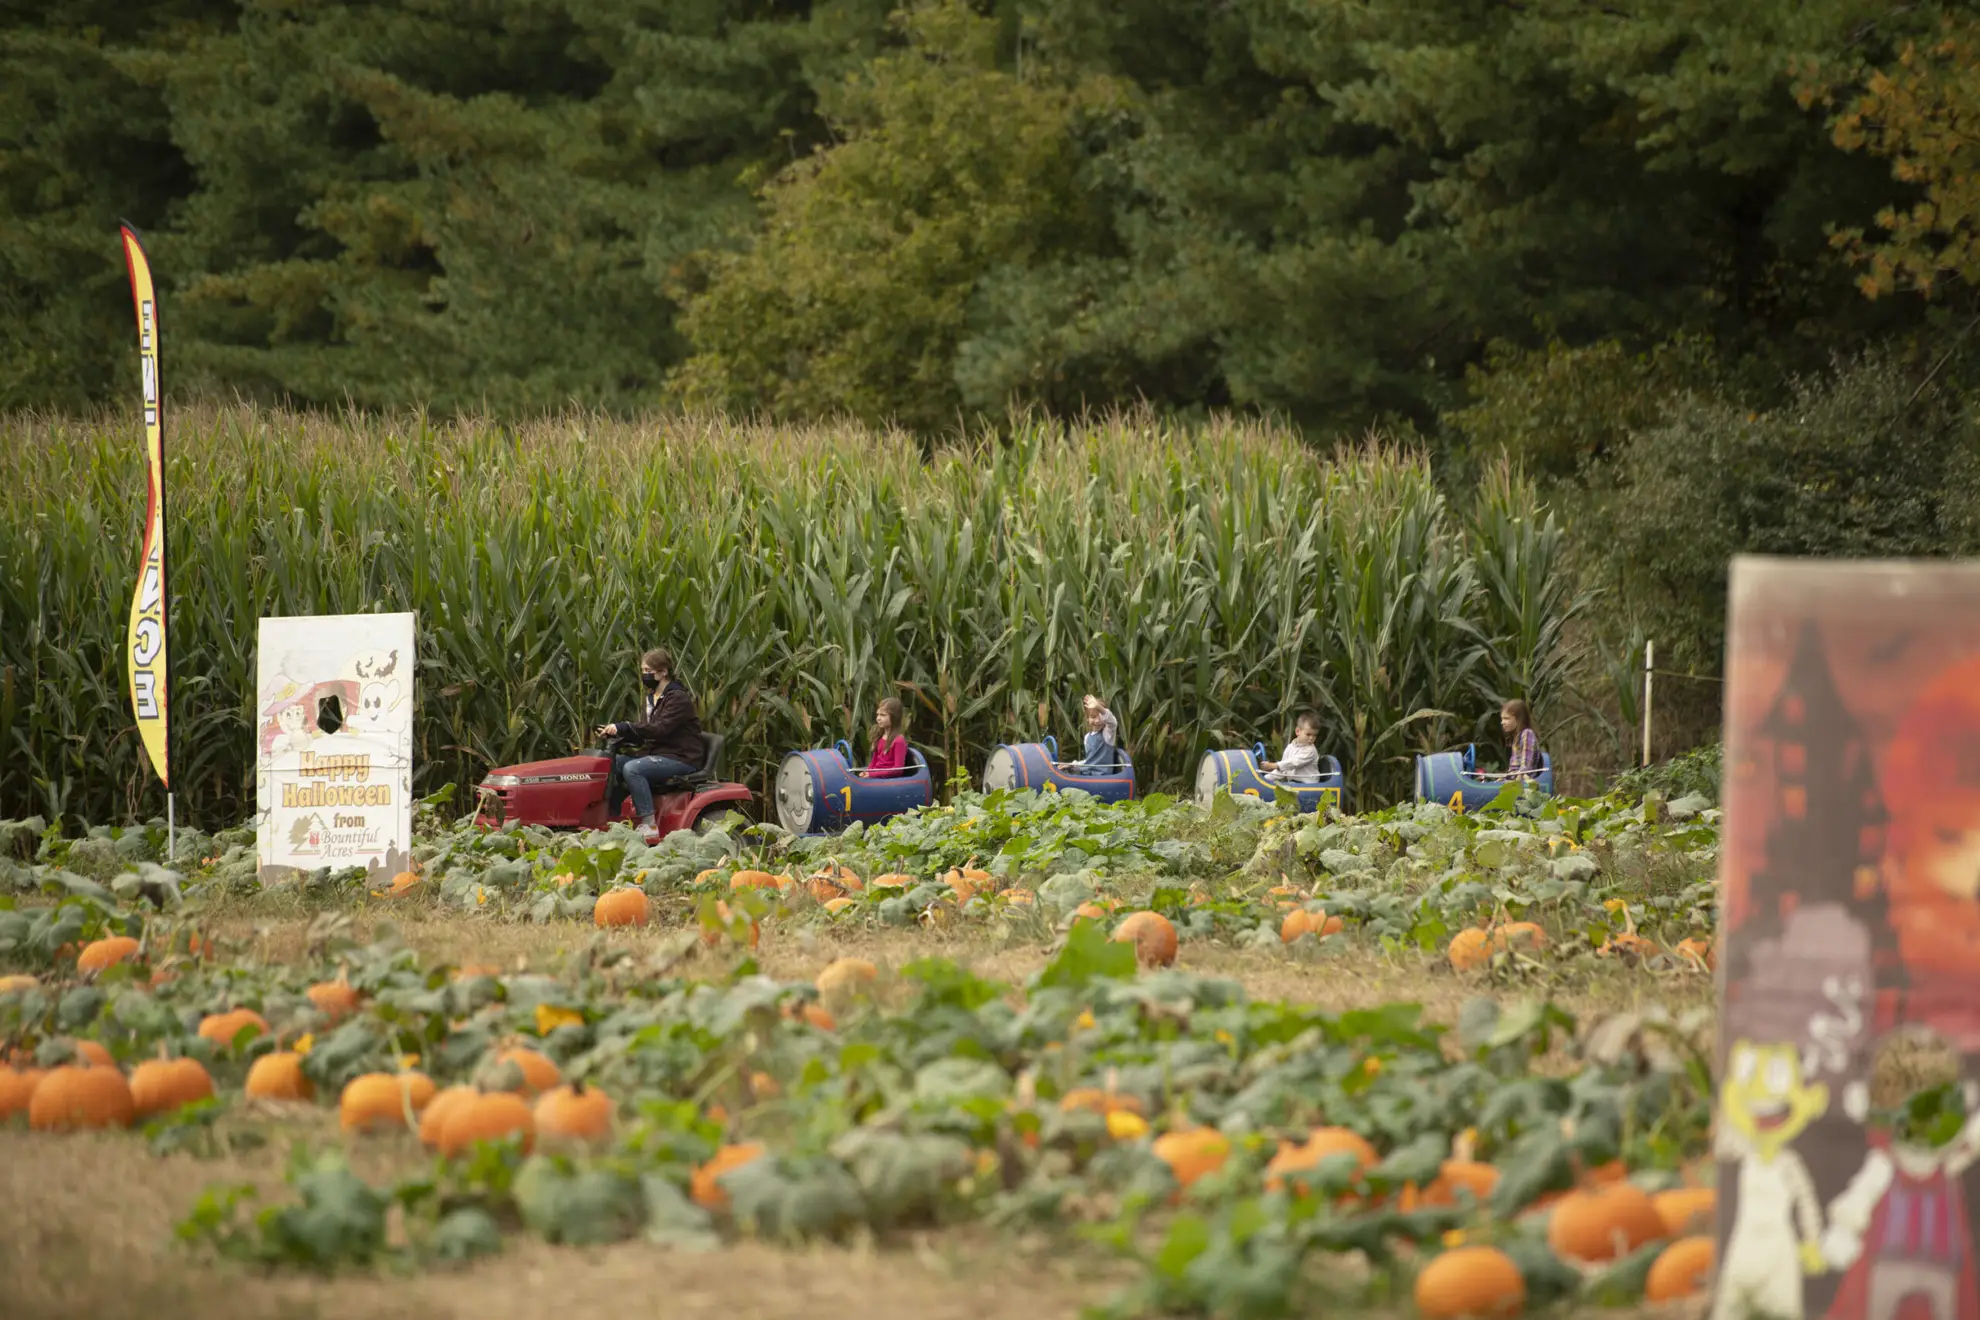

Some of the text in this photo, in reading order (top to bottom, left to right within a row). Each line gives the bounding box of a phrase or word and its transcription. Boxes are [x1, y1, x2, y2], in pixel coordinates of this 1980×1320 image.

[299, 751, 370, 782] Happy
[282, 782, 391, 808] Halloween
[839, 785, 852, 812] 1
[1447, 790, 1466, 816] 4
[333, 813, 365, 828] from
[321, 828, 380, 847] Bountiful
[321, 844, 354, 859] Acres
